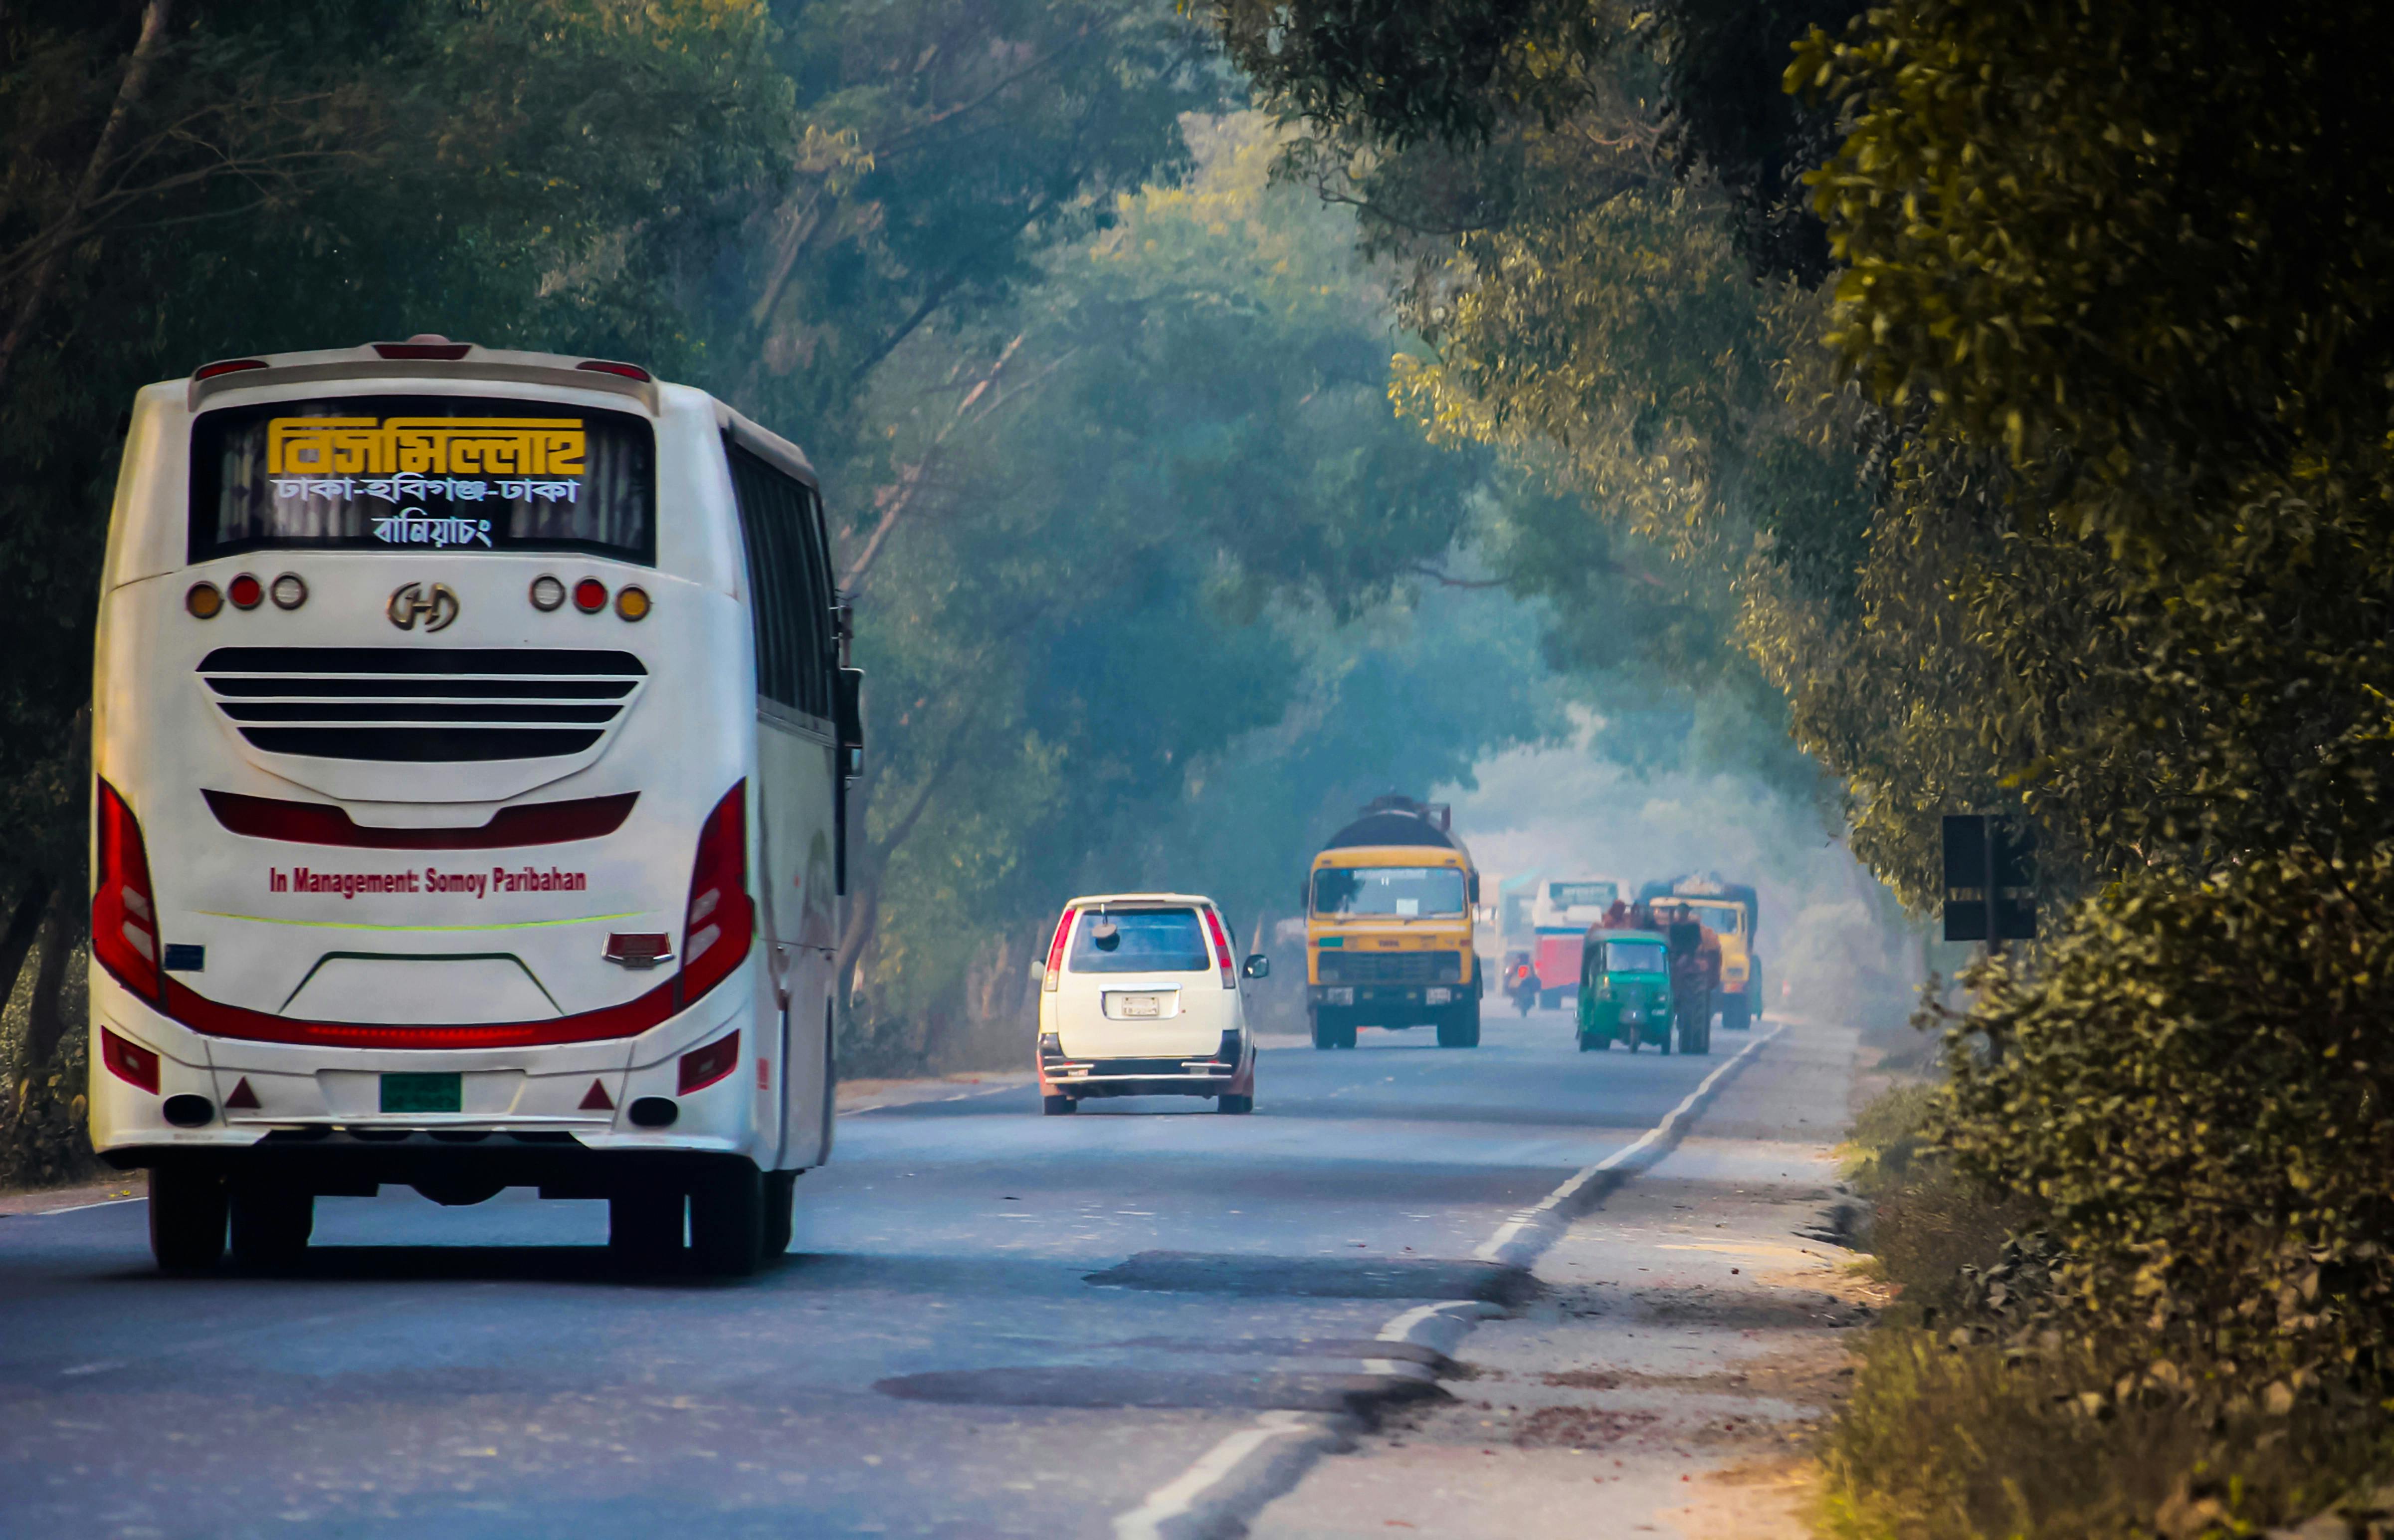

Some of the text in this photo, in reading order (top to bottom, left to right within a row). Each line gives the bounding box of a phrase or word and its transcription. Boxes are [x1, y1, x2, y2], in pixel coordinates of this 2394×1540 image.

[268, 417, 585, 474] বিসমিল্লাহ
[269, 472, 581, 504] ঢাকা-হবিগঞ্জ-ঢাকা
[371, 507, 492, 548] বানিয়াচং
[270, 867, 586, 899] In Management: Somoy Paribahan
